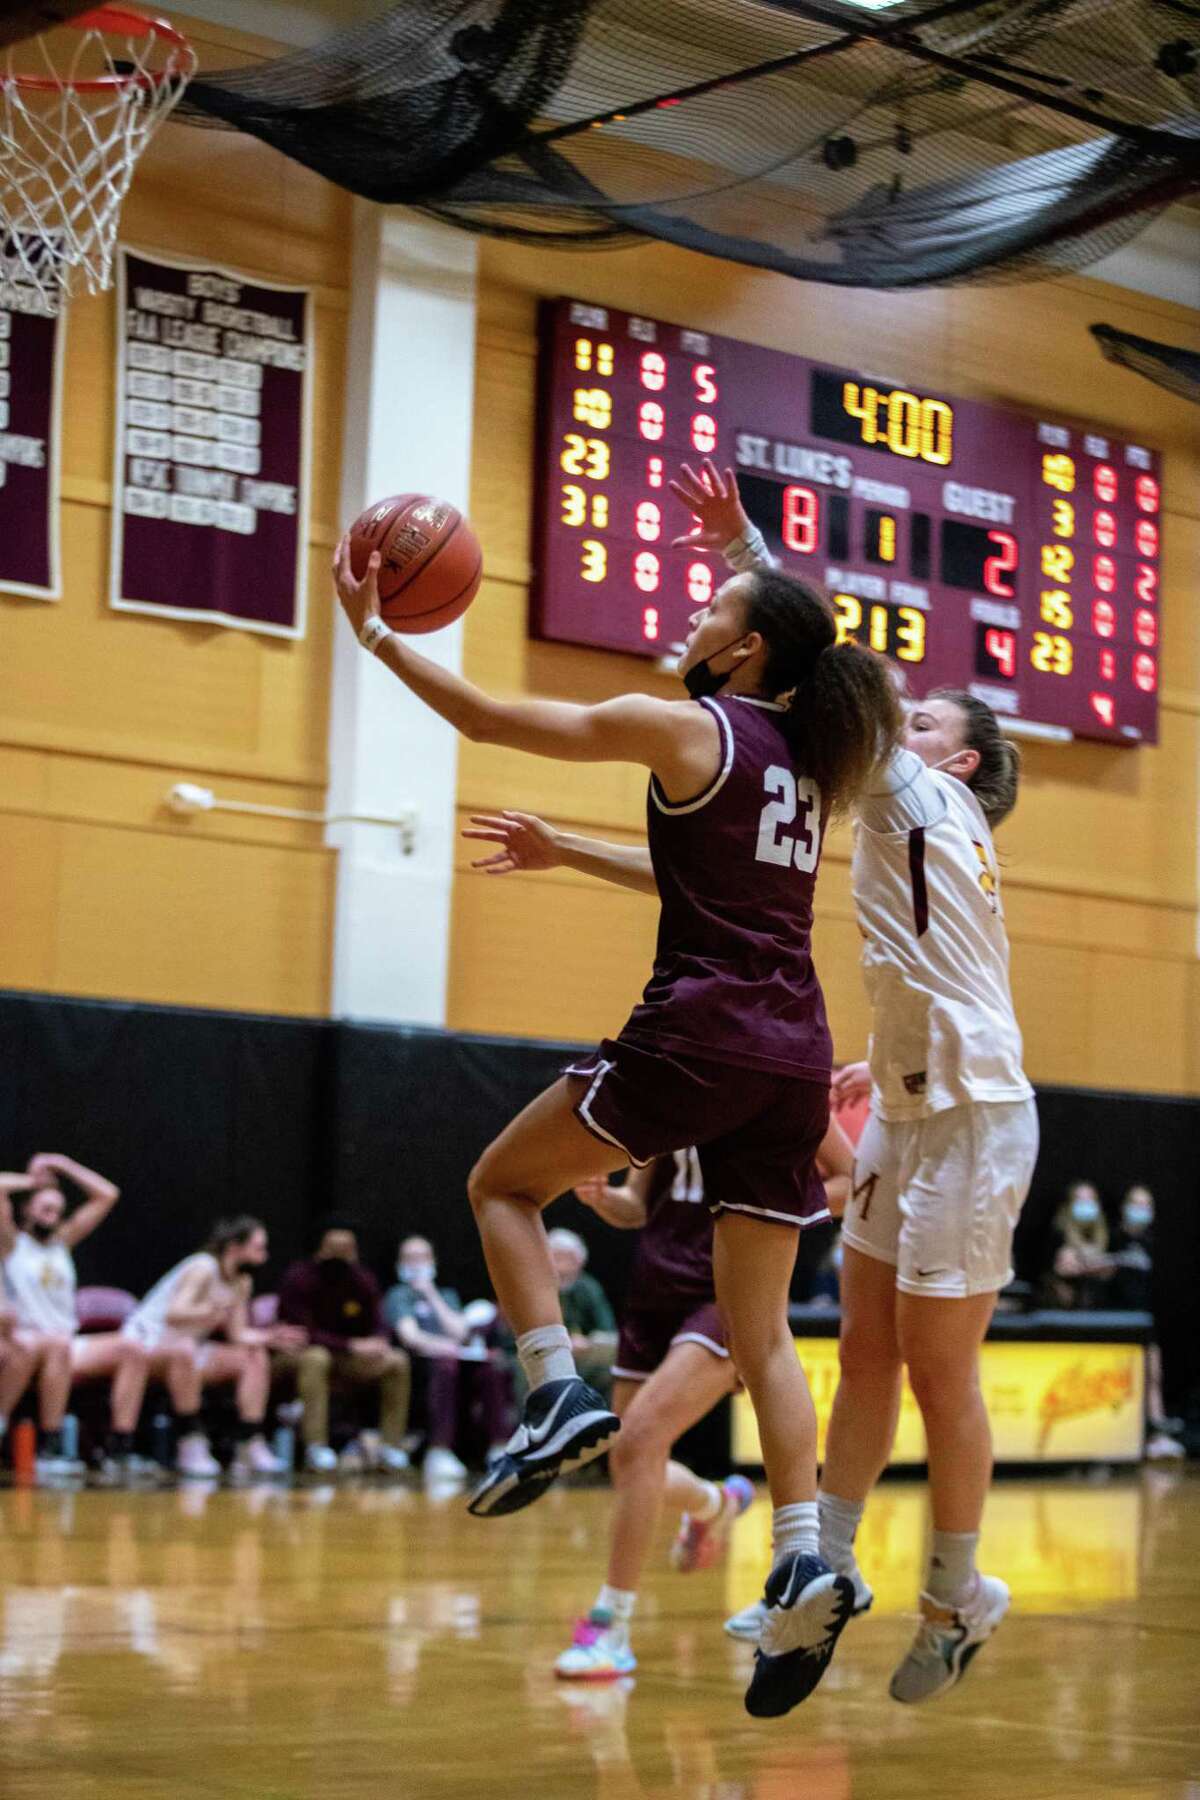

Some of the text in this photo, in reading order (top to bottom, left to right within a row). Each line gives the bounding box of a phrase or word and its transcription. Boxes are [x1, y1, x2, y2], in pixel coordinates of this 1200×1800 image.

[575, 338, 614, 376] 11
[692, 365, 718, 404] 5
[843, 382, 953, 466] 4:00
[560, 433, 610, 480] 23
[649, 457, 663, 488] 1
[561, 484, 608, 528] 31
[782, 485, 819, 554] 8
[943, 480, 1015, 524] GUEST
[1052, 499, 1075, 538] 3
[580, 540, 607, 582] 3
[878, 516, 896, 562] 1
[983, 530, 1019, 598] 2
[1134, 563, 1157, 602] 2
[644, 607, 658, 640] 1
[985, 628, 1016, 678] 4
[1030, 631, 1073, 676] 23
[755, 764, 821, 875] 23
